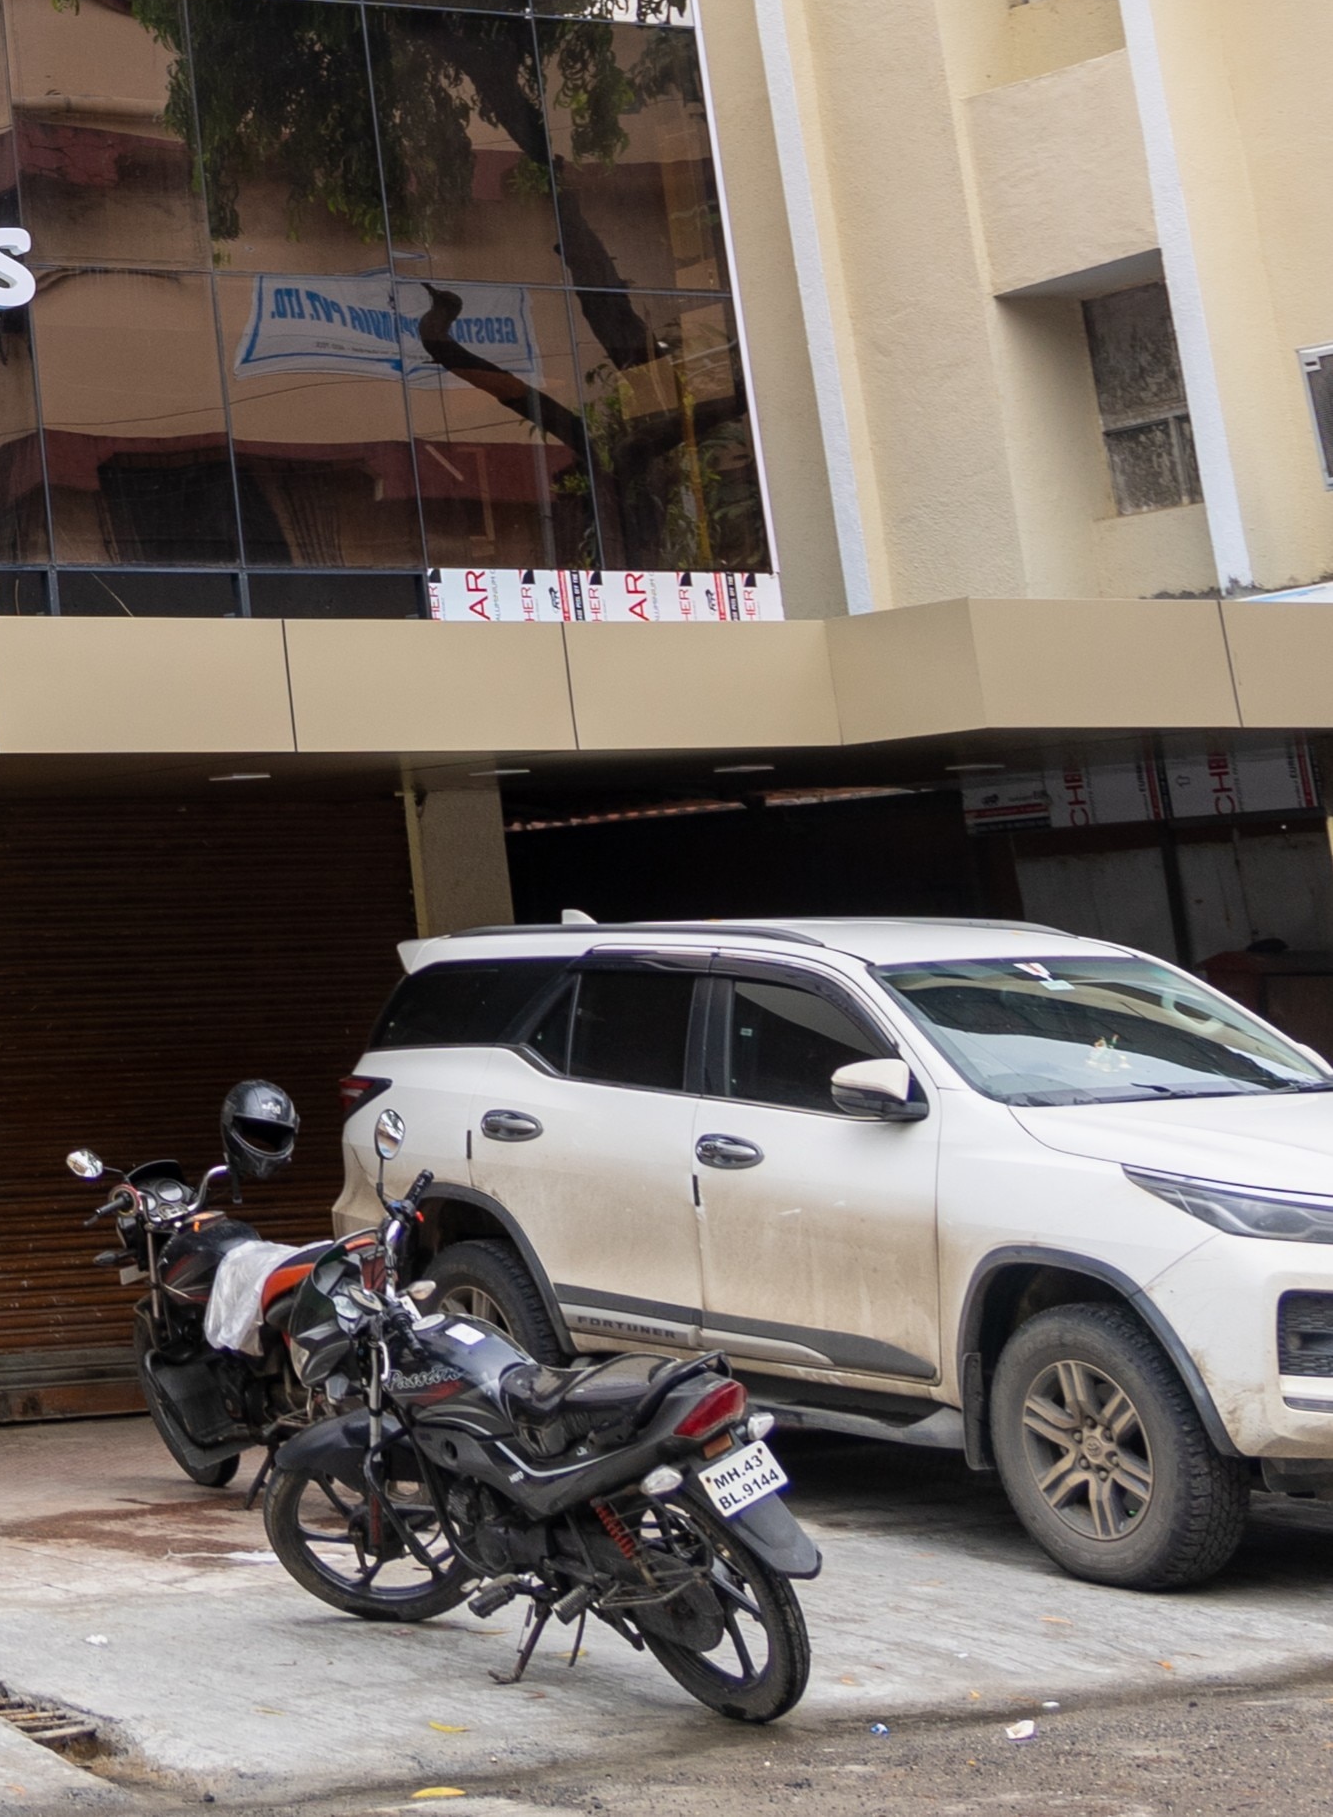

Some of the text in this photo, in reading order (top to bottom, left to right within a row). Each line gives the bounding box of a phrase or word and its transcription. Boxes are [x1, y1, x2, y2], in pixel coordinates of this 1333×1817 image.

[577, 1315, 676, 1339] FORTUNER
[713, 1455, 763, 1490] MH.43
[718, 1468, 780, 1511] BL.9144
